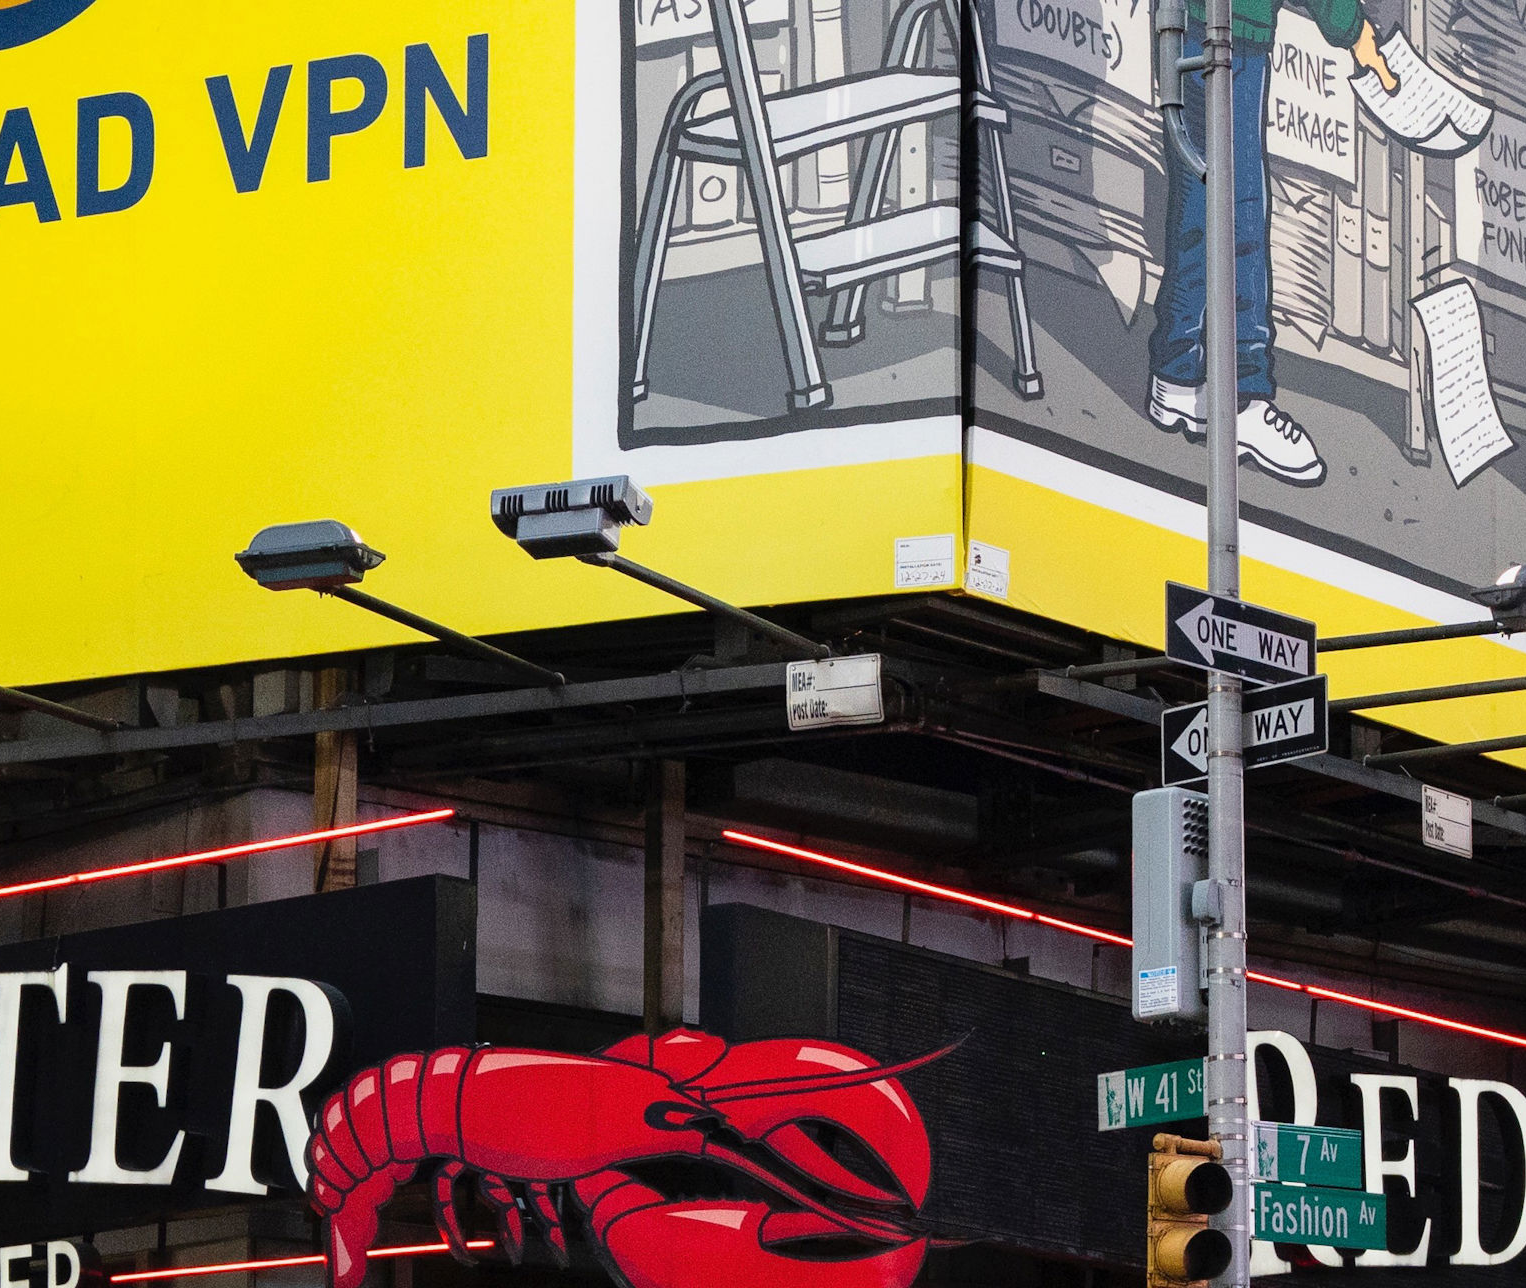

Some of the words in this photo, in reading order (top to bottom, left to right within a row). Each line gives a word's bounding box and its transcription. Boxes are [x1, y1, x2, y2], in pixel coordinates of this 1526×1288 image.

[204, 33, 489, 194] VPN
[1267, 97, 1349, 158] EAKAGE
[1197, 615, 1238, 653] ONE
[1258, 630, 1300, 668] WAY
[1255, 704, 1305, 742] WAY
[1127, 1077, 1146, 1118] W
[1155, 1073, 1178, 1112] 41
[1187, 1070, 1203, 1095] St
[1296, 1134, 1310, 1176] 7
[1320, 1138, 1338, 1164] Av
[1260, 1190, 1349, 1239] Fashion
[1359, 1204, 1375, 1226] Av
